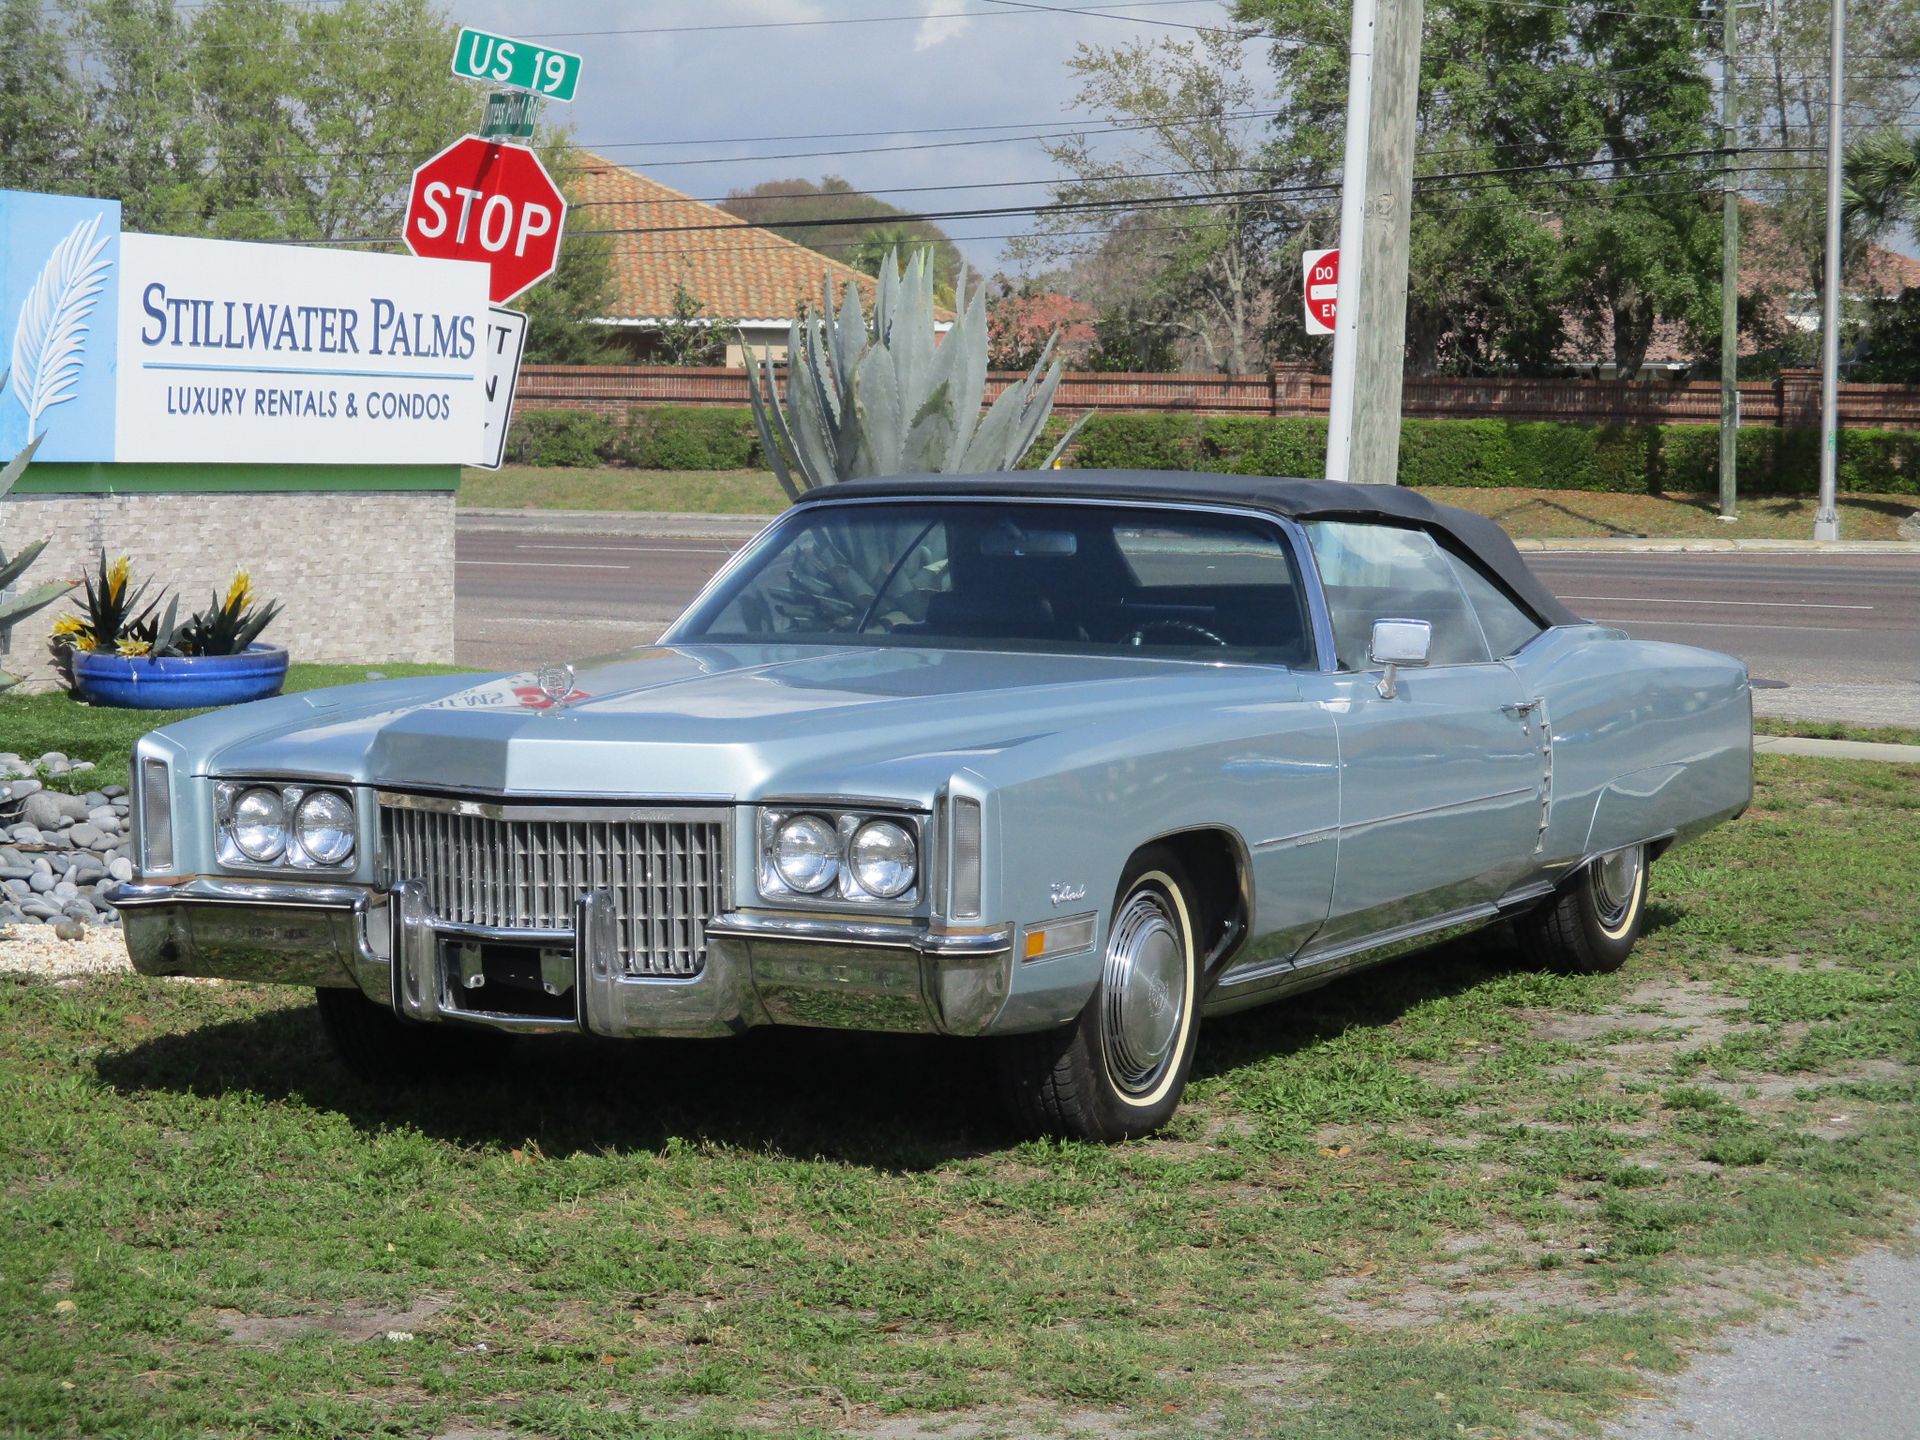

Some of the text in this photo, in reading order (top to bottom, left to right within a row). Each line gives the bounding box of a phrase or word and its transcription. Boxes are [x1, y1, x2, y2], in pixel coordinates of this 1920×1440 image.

[469, 35, 565, 93] US 19
[417, 181, 551, 257] STOP
[1316, 266, 1333, 280] DO
[167, 386, 450, 421] LUXURY RENTALS & CONDOS
